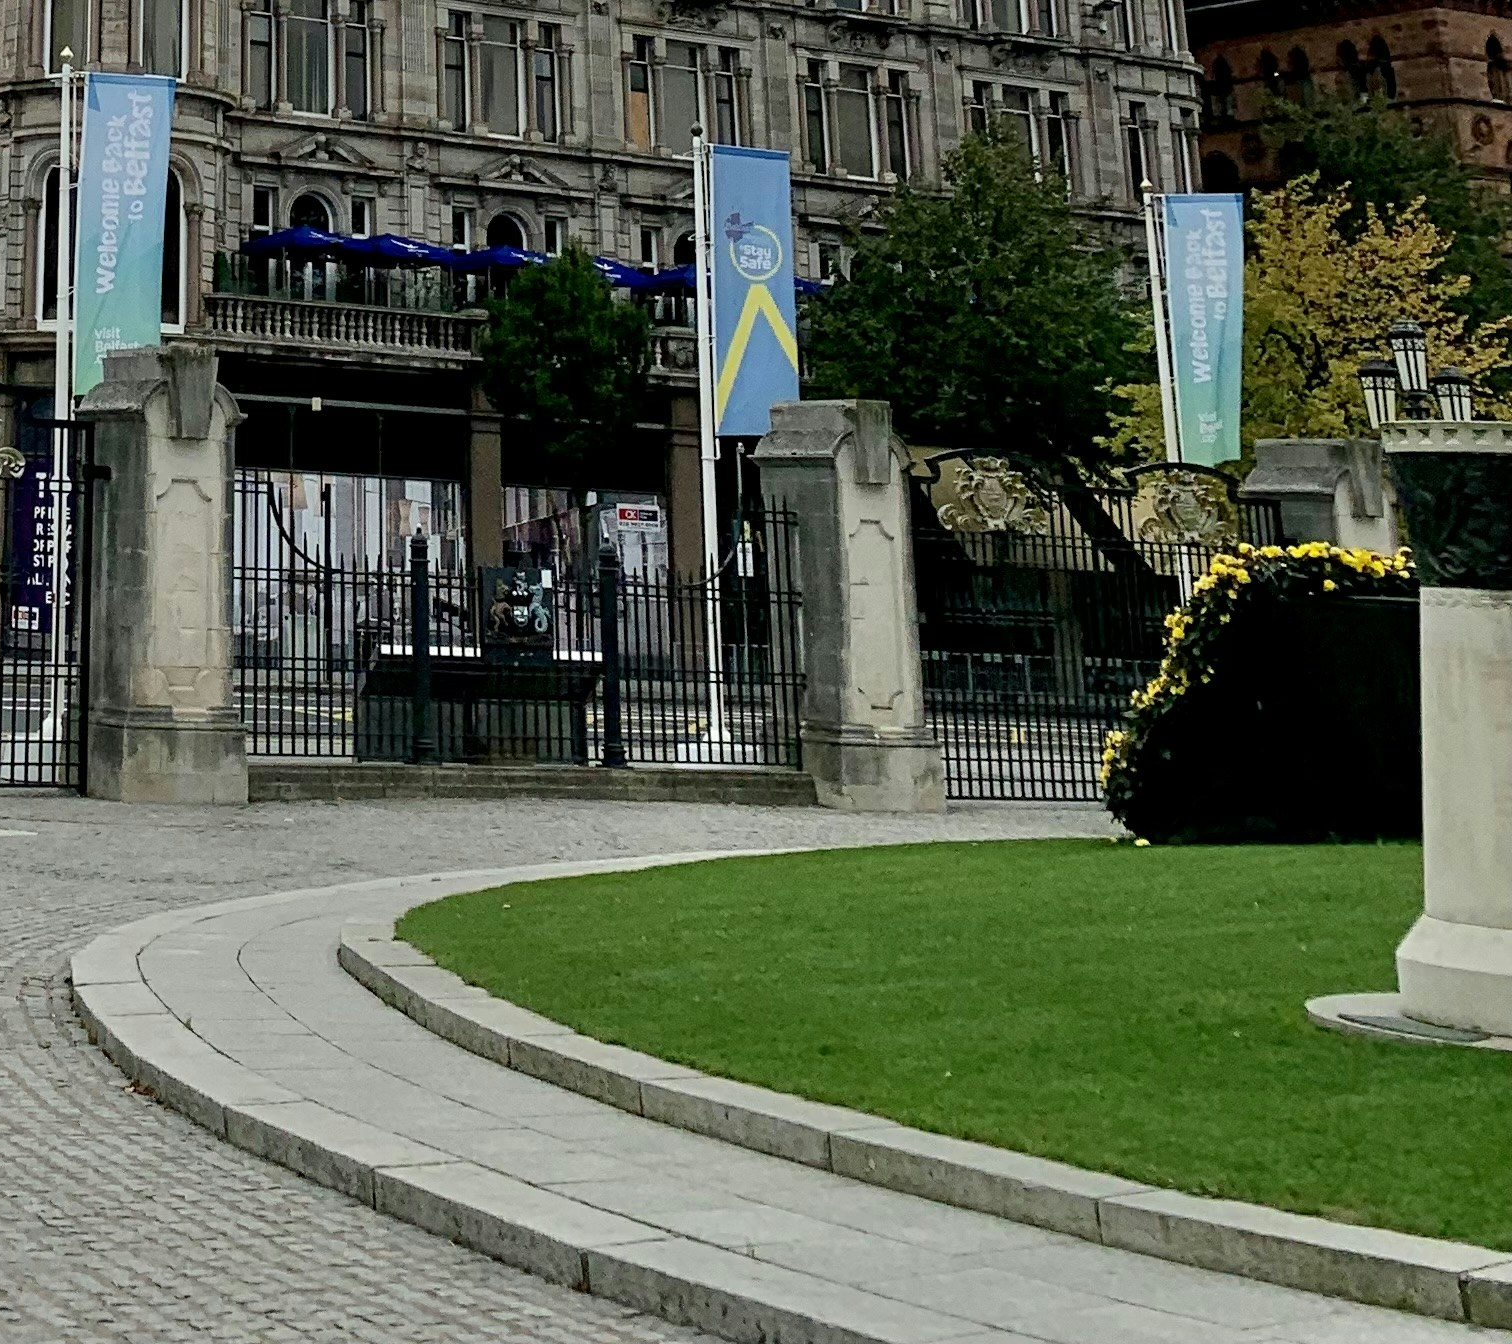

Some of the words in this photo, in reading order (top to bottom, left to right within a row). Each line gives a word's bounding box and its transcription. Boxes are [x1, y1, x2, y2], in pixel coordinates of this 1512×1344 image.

[102, 115, 127, 172] Back
[123, 89, 154, 196] Belfast
[96, 178, 120, 294] Welcome
[128, 200, 144, 224] to
[1200, 209, 1227, 298] Belfast
[740, 255, 772, 270] Safe
[1187, 284, 1211, 384] Welcome
